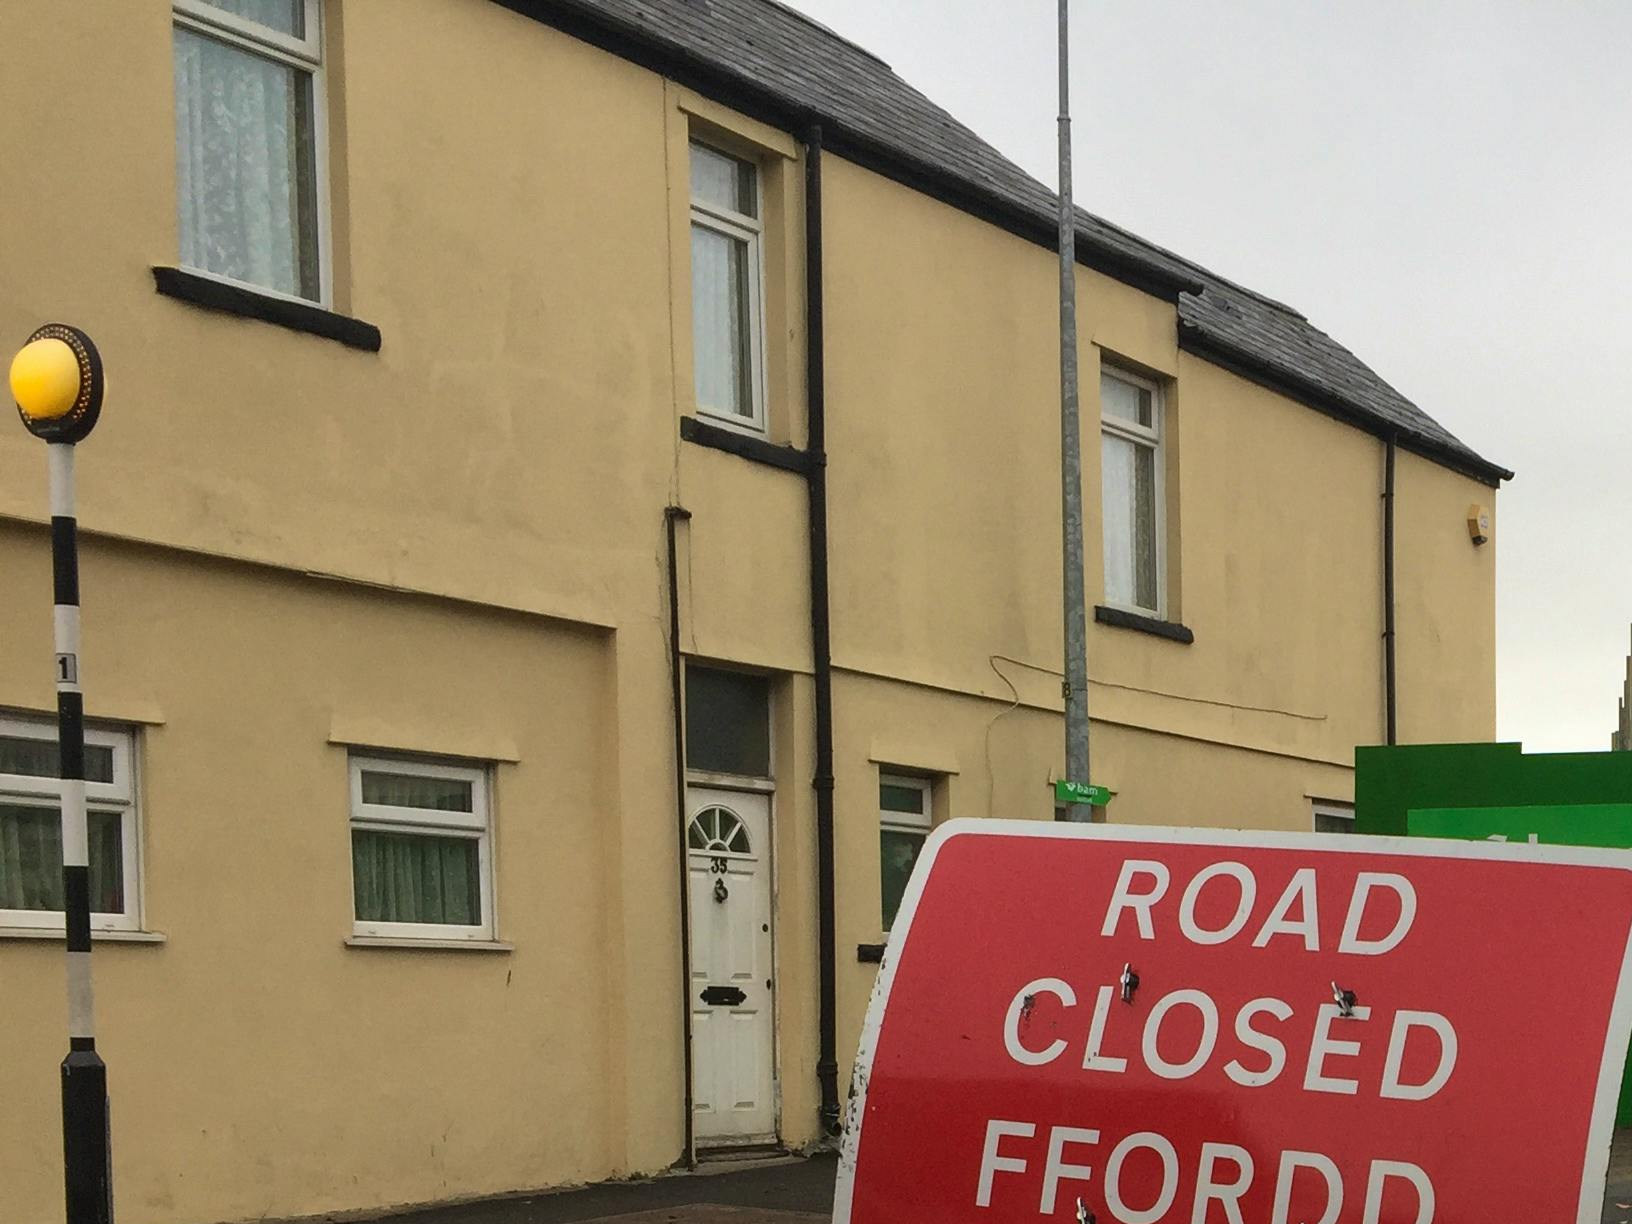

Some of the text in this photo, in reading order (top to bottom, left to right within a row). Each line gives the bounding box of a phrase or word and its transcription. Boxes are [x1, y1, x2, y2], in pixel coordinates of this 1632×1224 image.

[58, 656, 68, 680] 1
[1077, 783, 1098, 796] bam
[710, 856, 728, 873] 35
[1100, 859, 1417, 956] ROAD
[1003, 977, 1458, 1101] CLOSED
